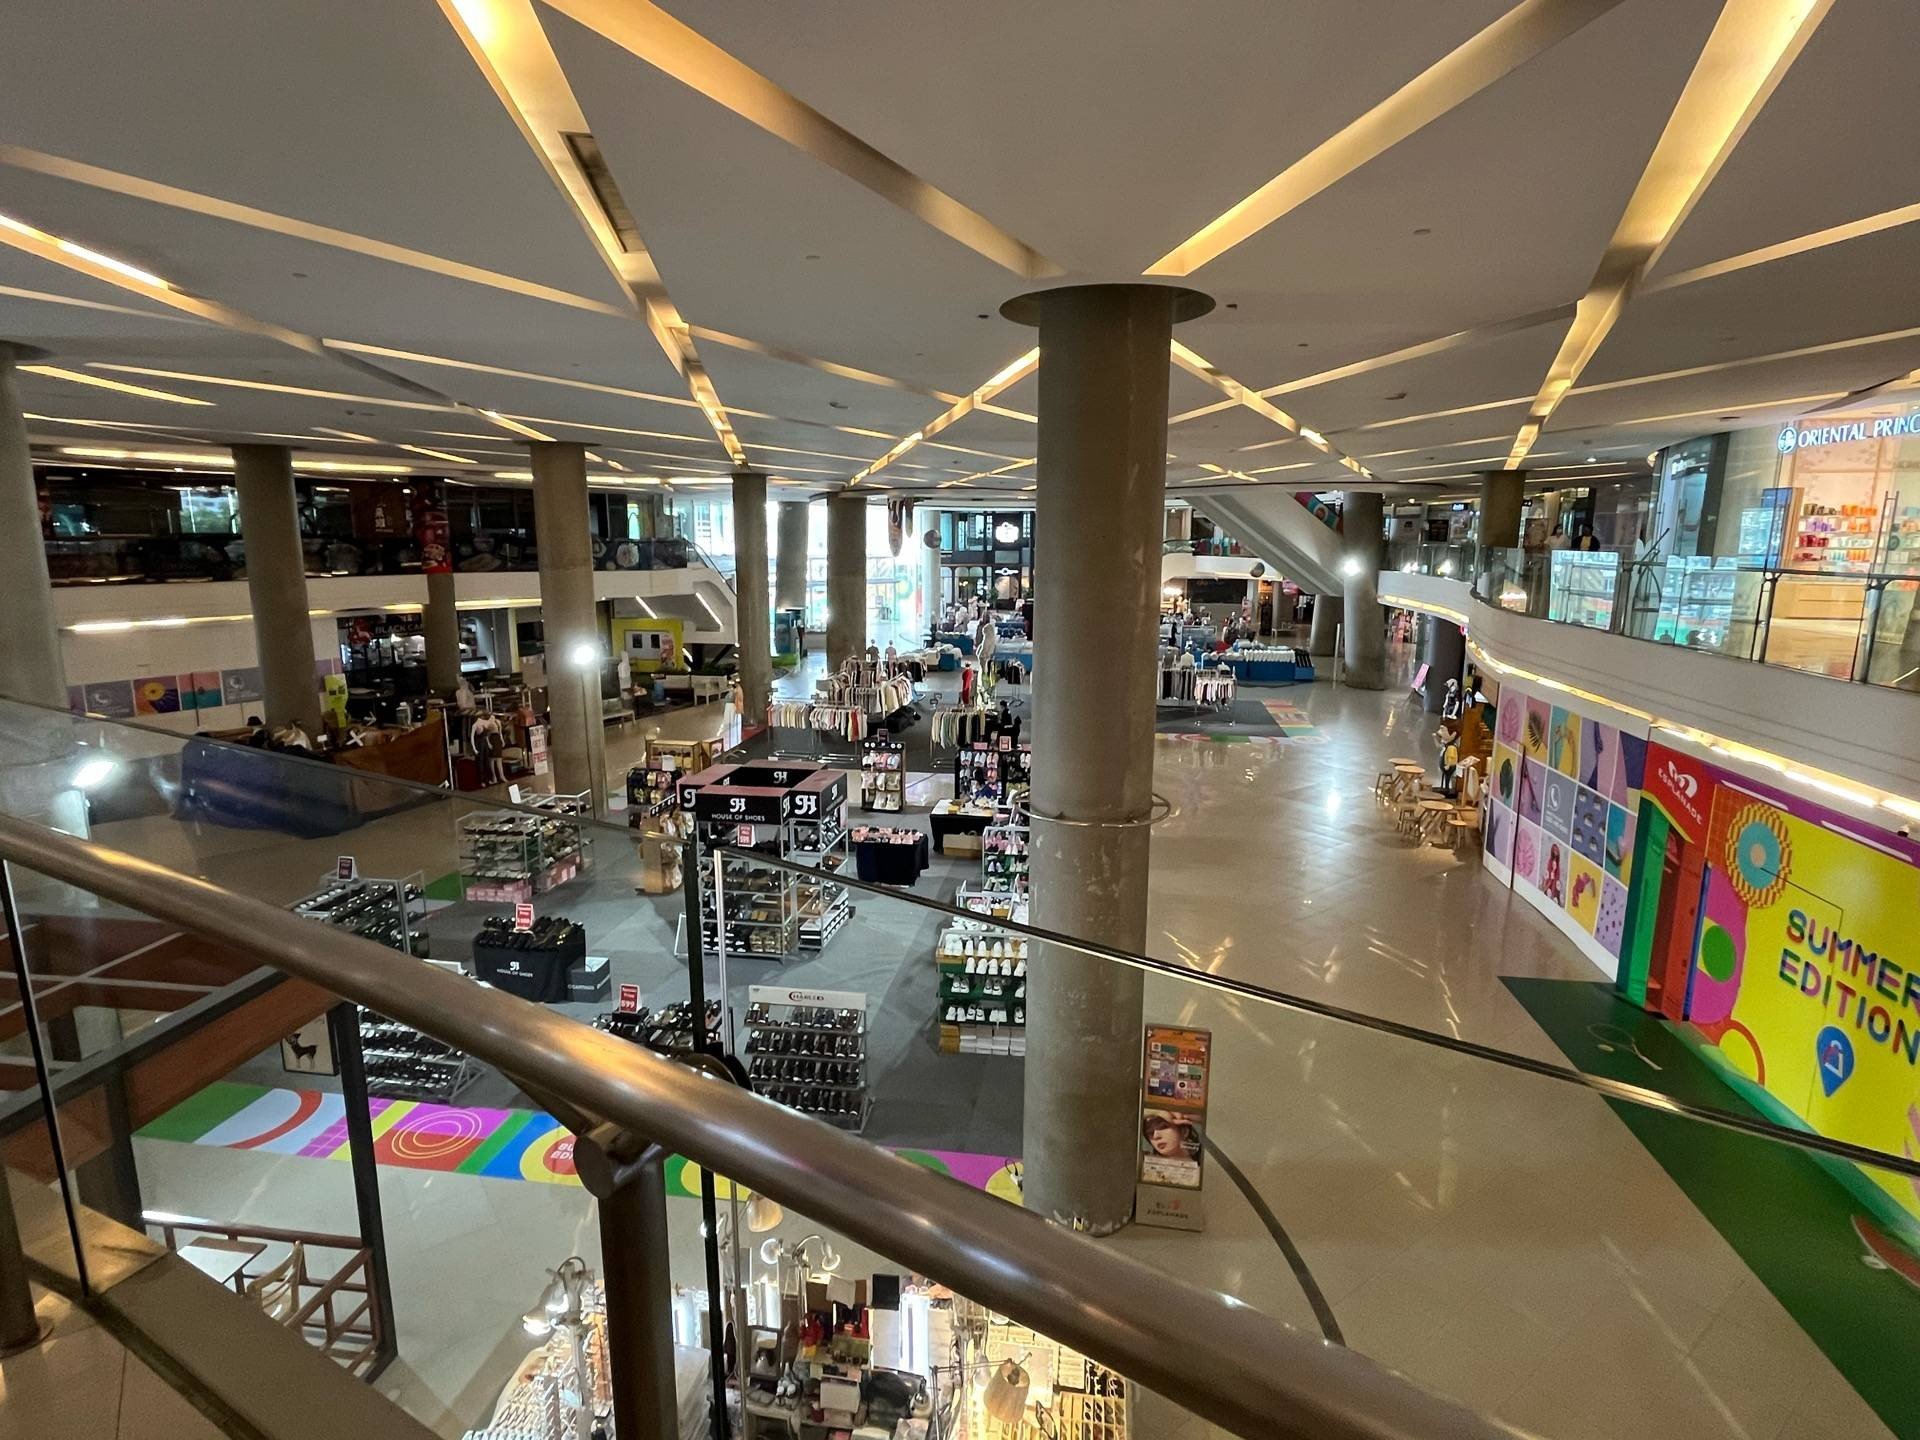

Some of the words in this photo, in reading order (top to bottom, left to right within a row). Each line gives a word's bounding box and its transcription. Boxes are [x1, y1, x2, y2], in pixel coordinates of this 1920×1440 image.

[1798, 422, 1867, 448] ORIENTAL
[711, 813, 733, 821] HOUSE
[1658, 768, 1703, 825] ESPLANADE
[1779, 948, 1920, 1065] EDITION
